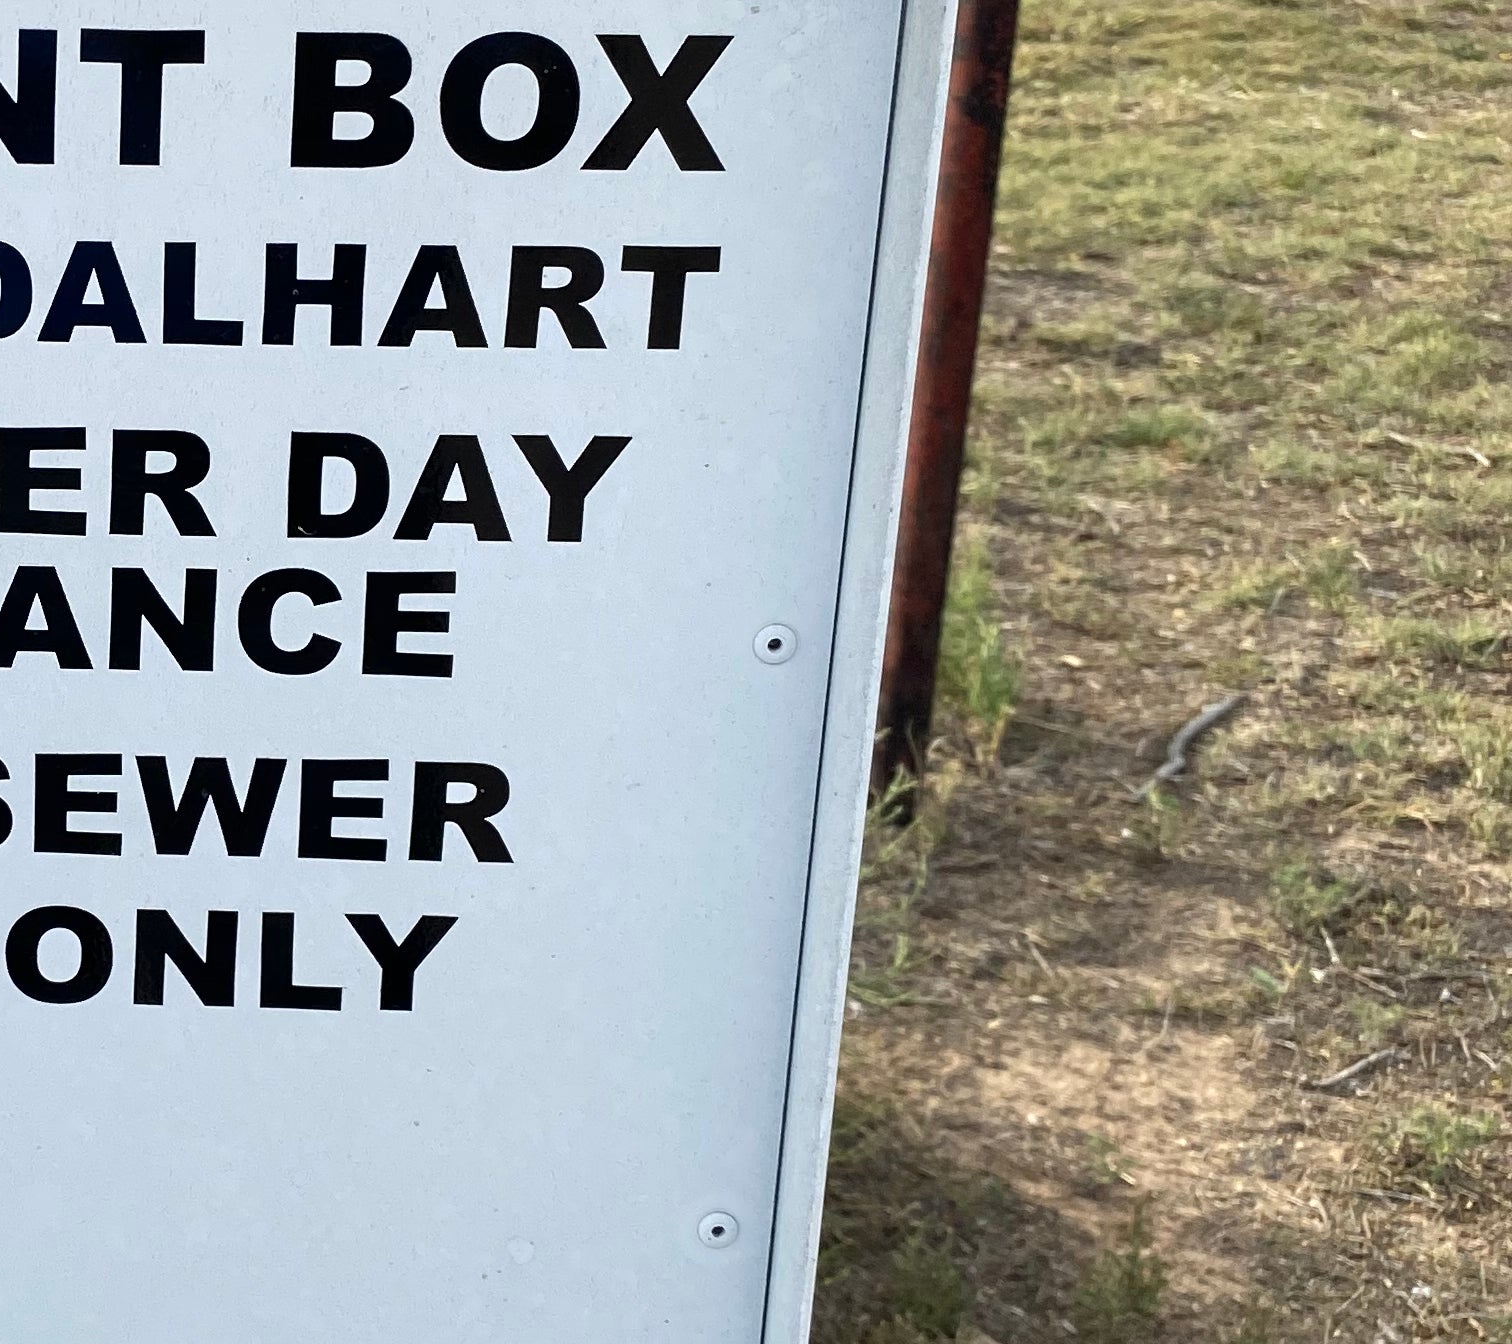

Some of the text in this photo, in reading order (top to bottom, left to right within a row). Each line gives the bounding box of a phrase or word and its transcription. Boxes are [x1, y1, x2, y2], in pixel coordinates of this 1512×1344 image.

[291, 32, 734, 171] BOX
[287, 431, 632, 542] DAY
[5, 906, 458, 1012] ONLY
